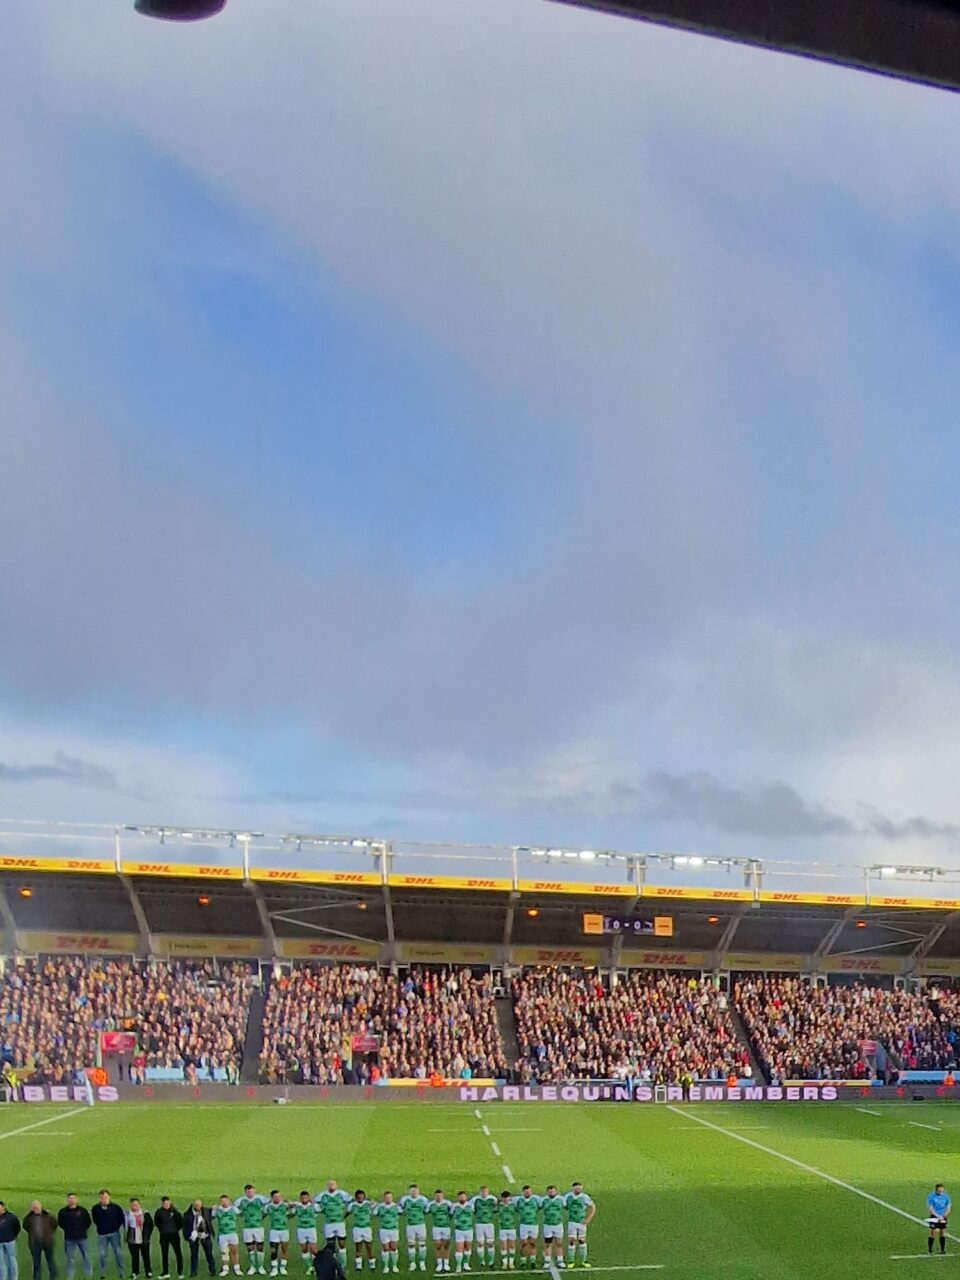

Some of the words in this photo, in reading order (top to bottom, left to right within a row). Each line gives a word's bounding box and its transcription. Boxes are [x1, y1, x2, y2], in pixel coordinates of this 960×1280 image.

[3, 859, 39, 867] DHL
[68, 861, 103, 869] DHL
[138, 864, 172, 872] DHL
[199, 868, 232, 876] DHL
[268, 871, 301, 879] DHL
[334, 874, 364, 882] DHL
[405, 877, 435, 885] DHL
[467, 880, 497, 888] DHL
[308, 943, 361, 956] DHL
[536, 950, 584, 962] DHL
[643, 954, 688, 965] DHL
[460, 1086, 653, 1101] HARLEQUINS
[667, 1086, 838, 1101] REMEMBERS
